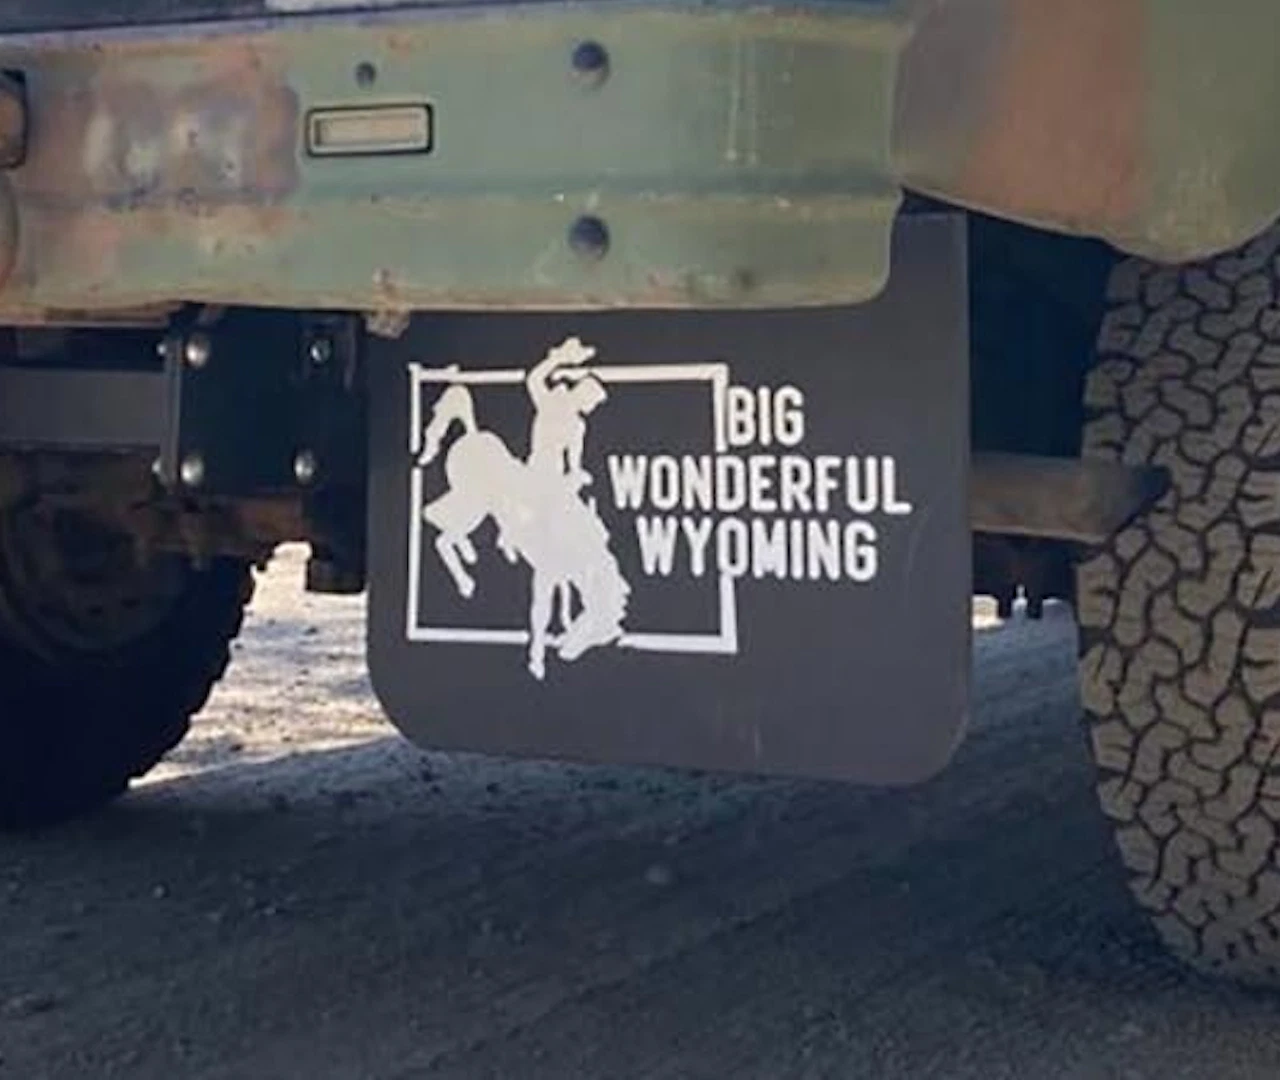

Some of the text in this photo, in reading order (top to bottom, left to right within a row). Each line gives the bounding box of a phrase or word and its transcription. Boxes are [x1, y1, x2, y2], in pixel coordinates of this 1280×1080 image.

[727, 385, 805, 446] BIG
[607, 454, 913, 515] WONDERFUL
[636, 517, 879, 582] WYOMING
